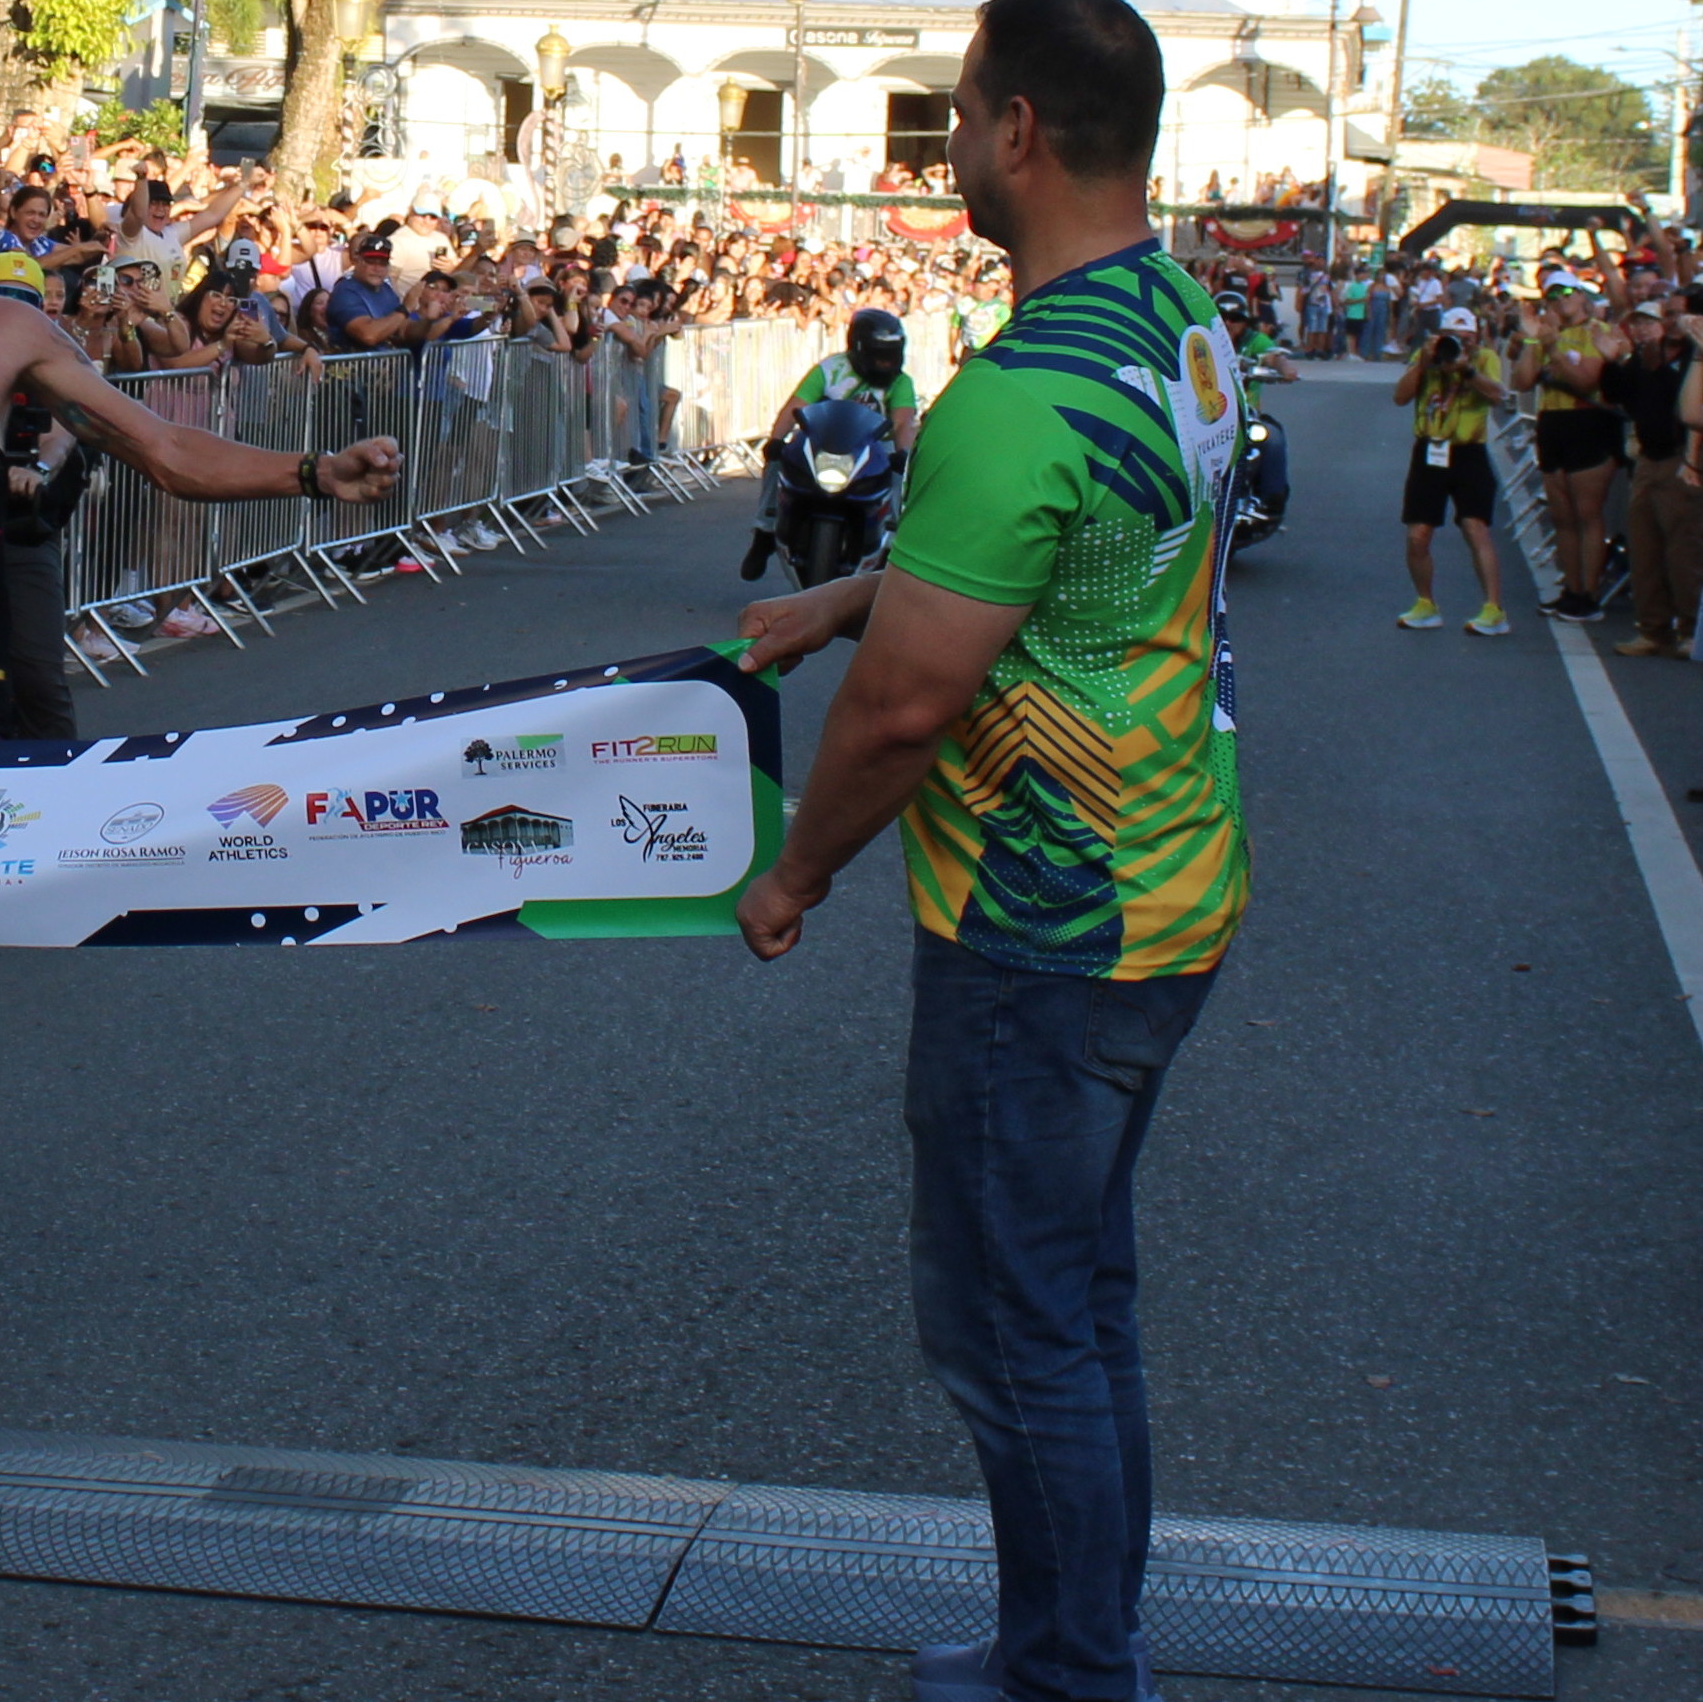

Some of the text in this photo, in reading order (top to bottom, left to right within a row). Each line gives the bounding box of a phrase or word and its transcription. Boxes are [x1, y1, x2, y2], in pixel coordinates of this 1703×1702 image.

[591, 735, 717, 759] FIT2RUN
[496, 749, 557, 761] PALERMO
[501, 759, 557, 770] SERVICES
[643, 803, 689, 813] FUNERARIA
[364, 821, 419, 830] DEPORTE
[611, 819, 626, 827] LOS
[219, 835, 274, 847] WORLD
[58, 845, 186, 861] JEISON ROSA RAMOS
[466, 840, 538, 855] CASONA
[209, 847, 288, 861] ATHLETICS
[497, 843, 573, 879] Figueroa
